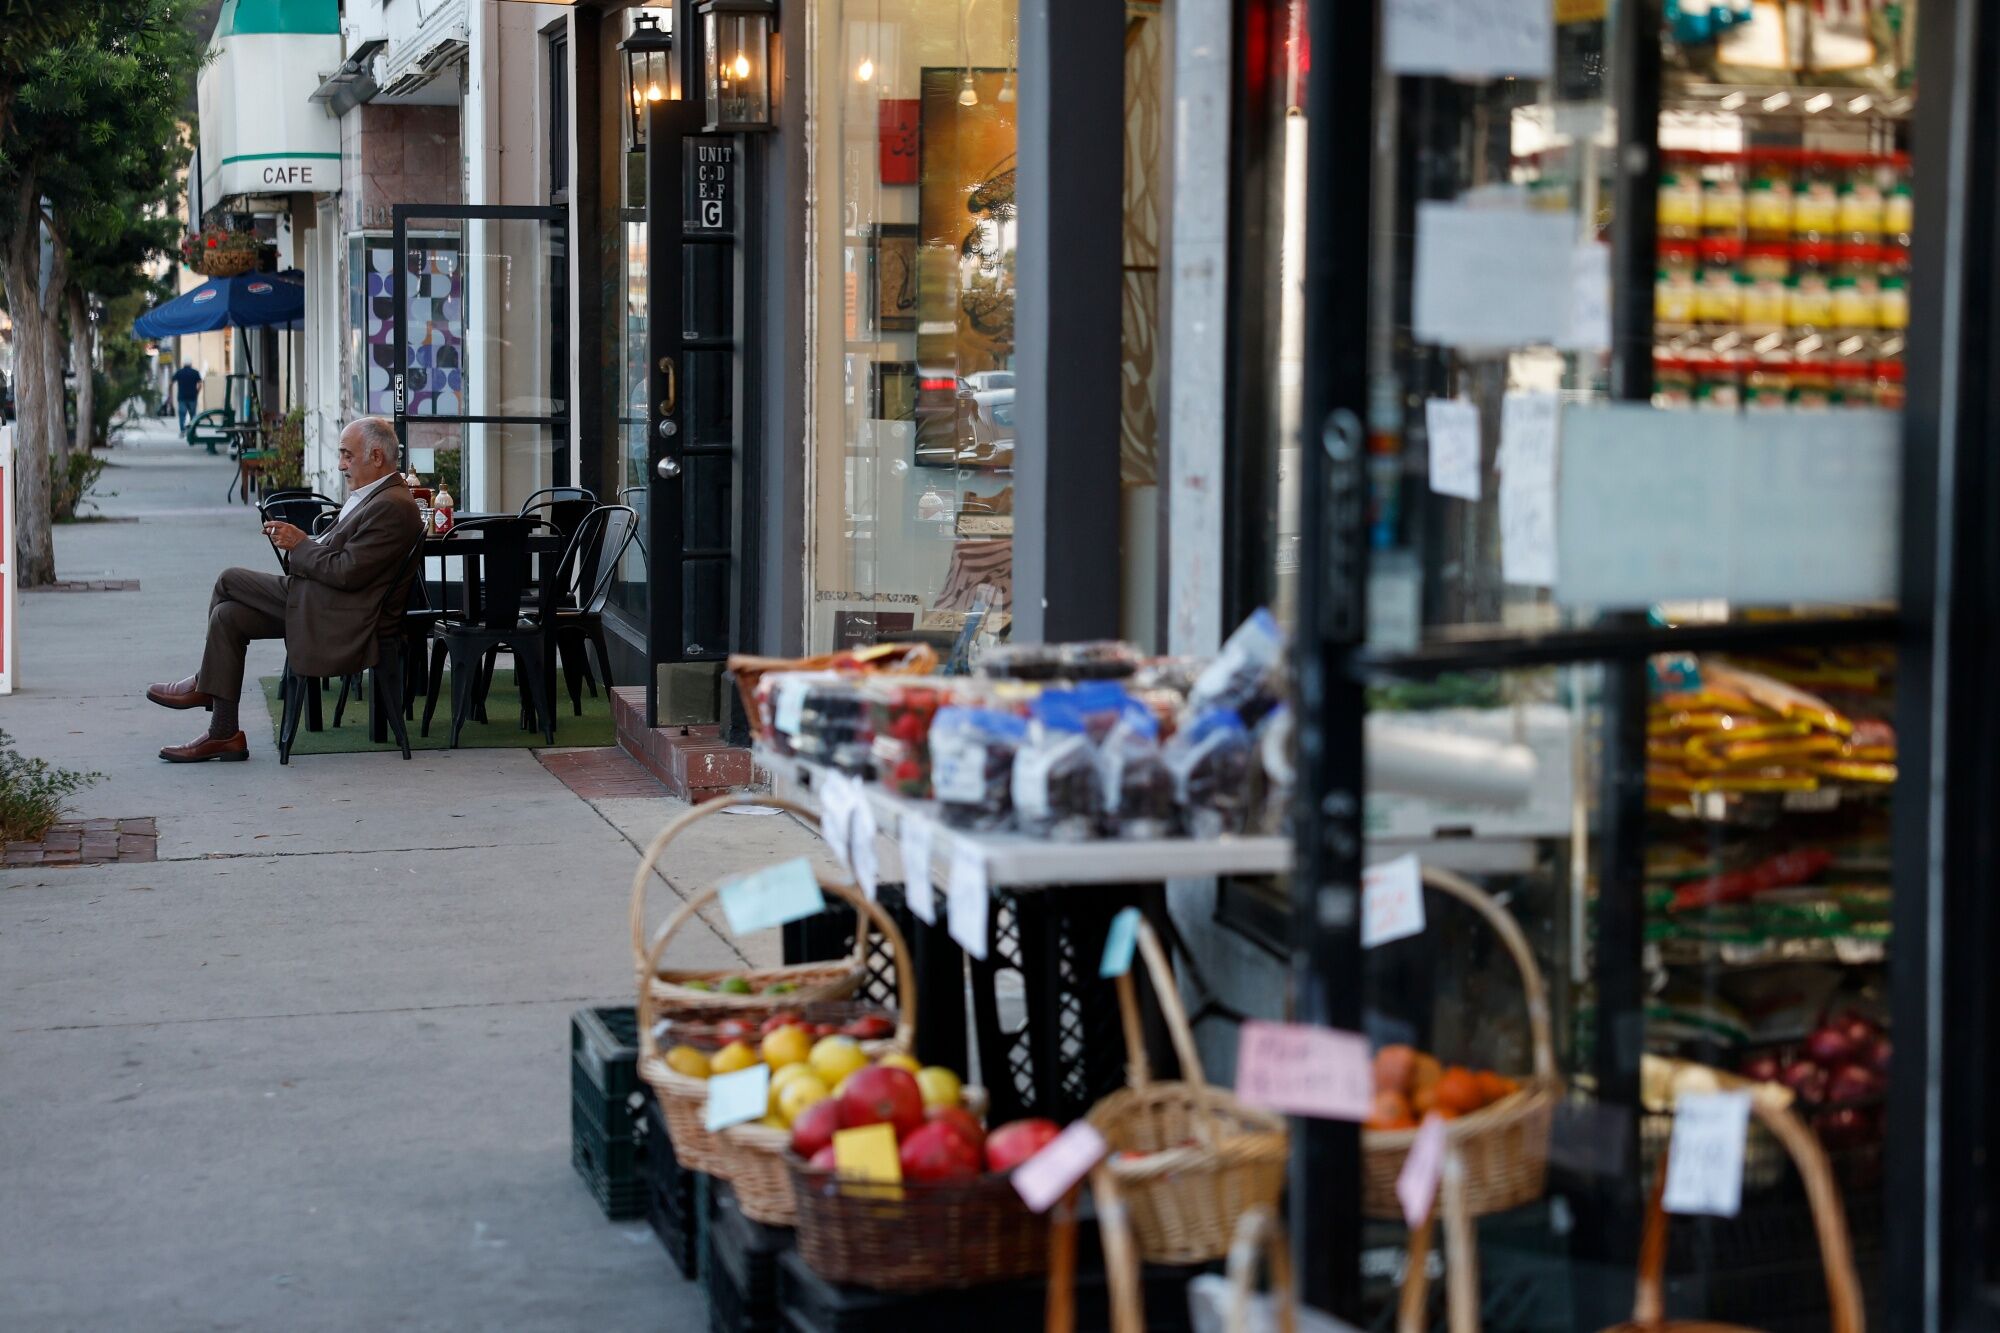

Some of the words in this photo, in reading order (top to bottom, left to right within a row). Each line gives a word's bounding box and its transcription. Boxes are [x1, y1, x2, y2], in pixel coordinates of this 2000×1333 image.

[698, 146, 732, 162] UNIT
[263, 166, 313, 184] CAFE
[704, 201, 721, 226] G
